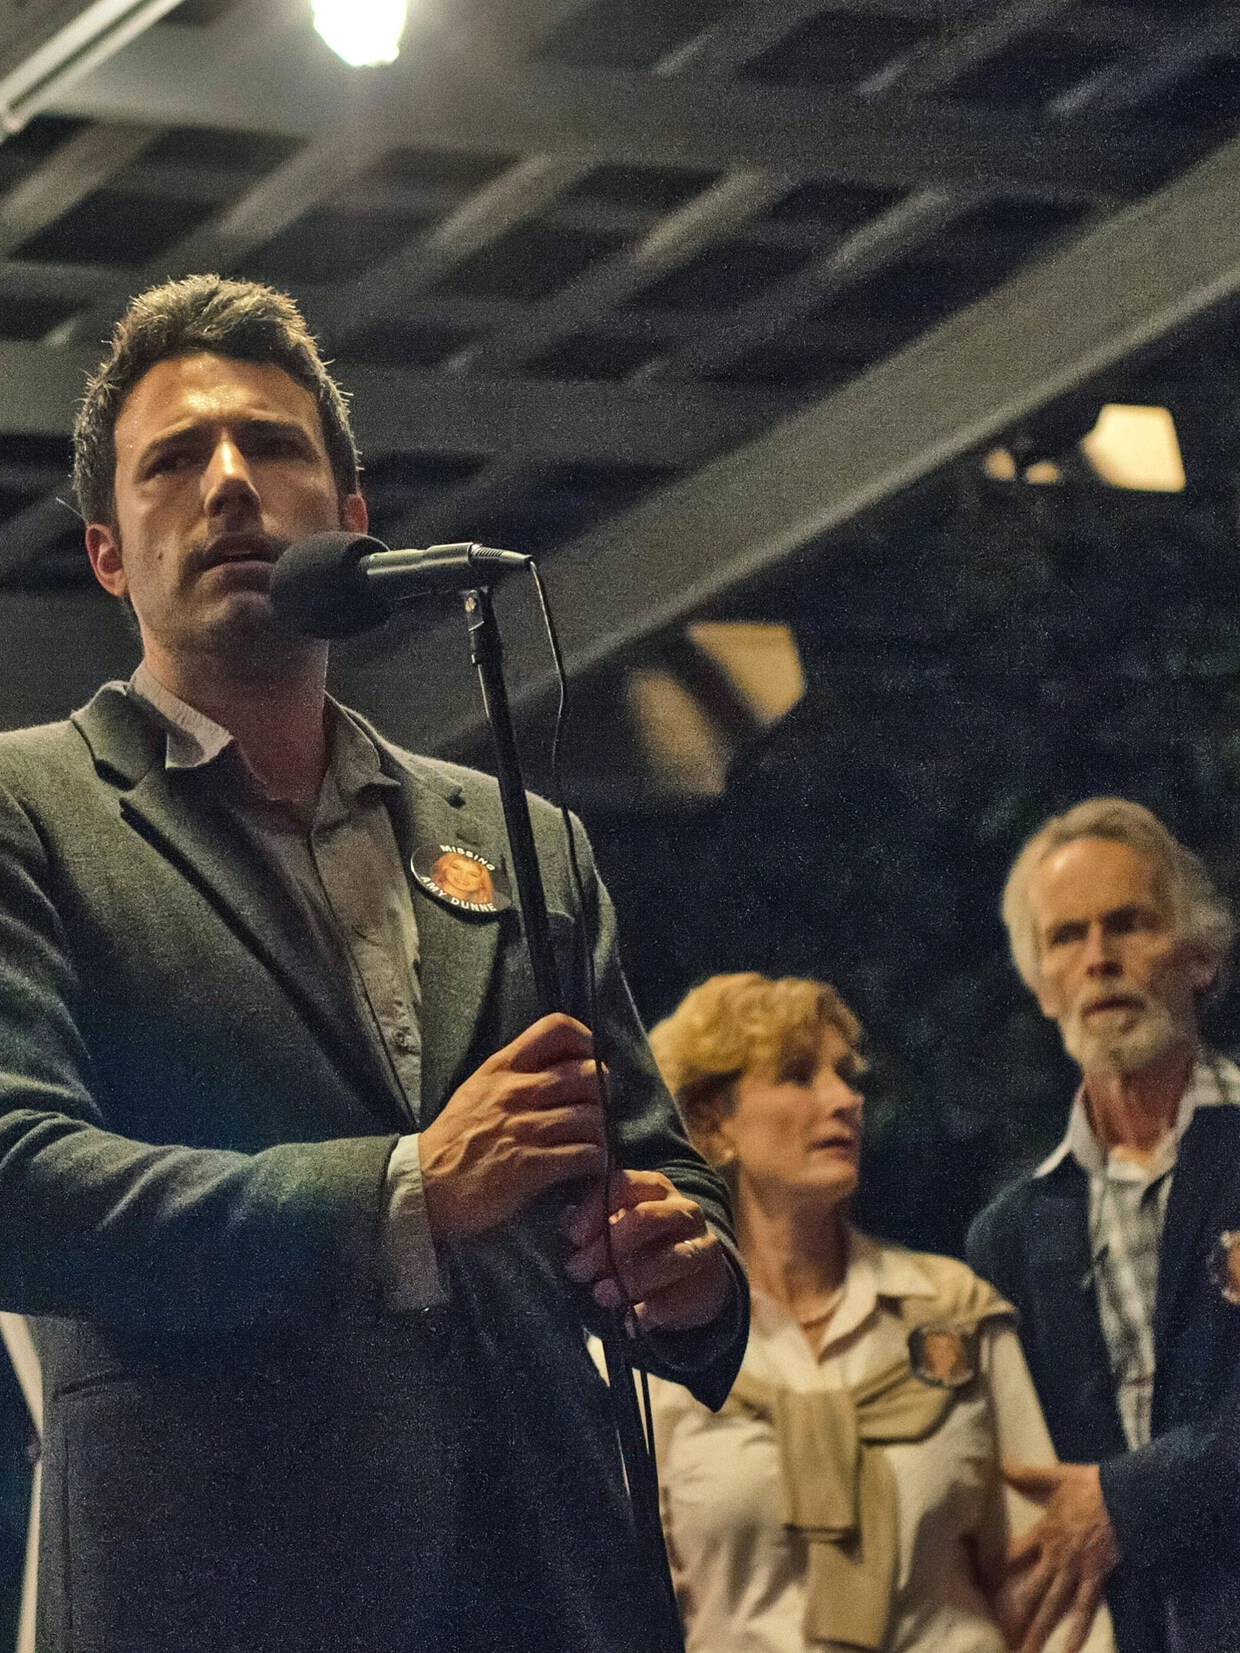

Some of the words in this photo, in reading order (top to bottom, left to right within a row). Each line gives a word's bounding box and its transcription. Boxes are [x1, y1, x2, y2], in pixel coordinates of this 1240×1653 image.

[440, 845, 495, 871] MISSING
[420, 876, 447, 897] AMY
[450, 897, 497, 912] DUNNE
